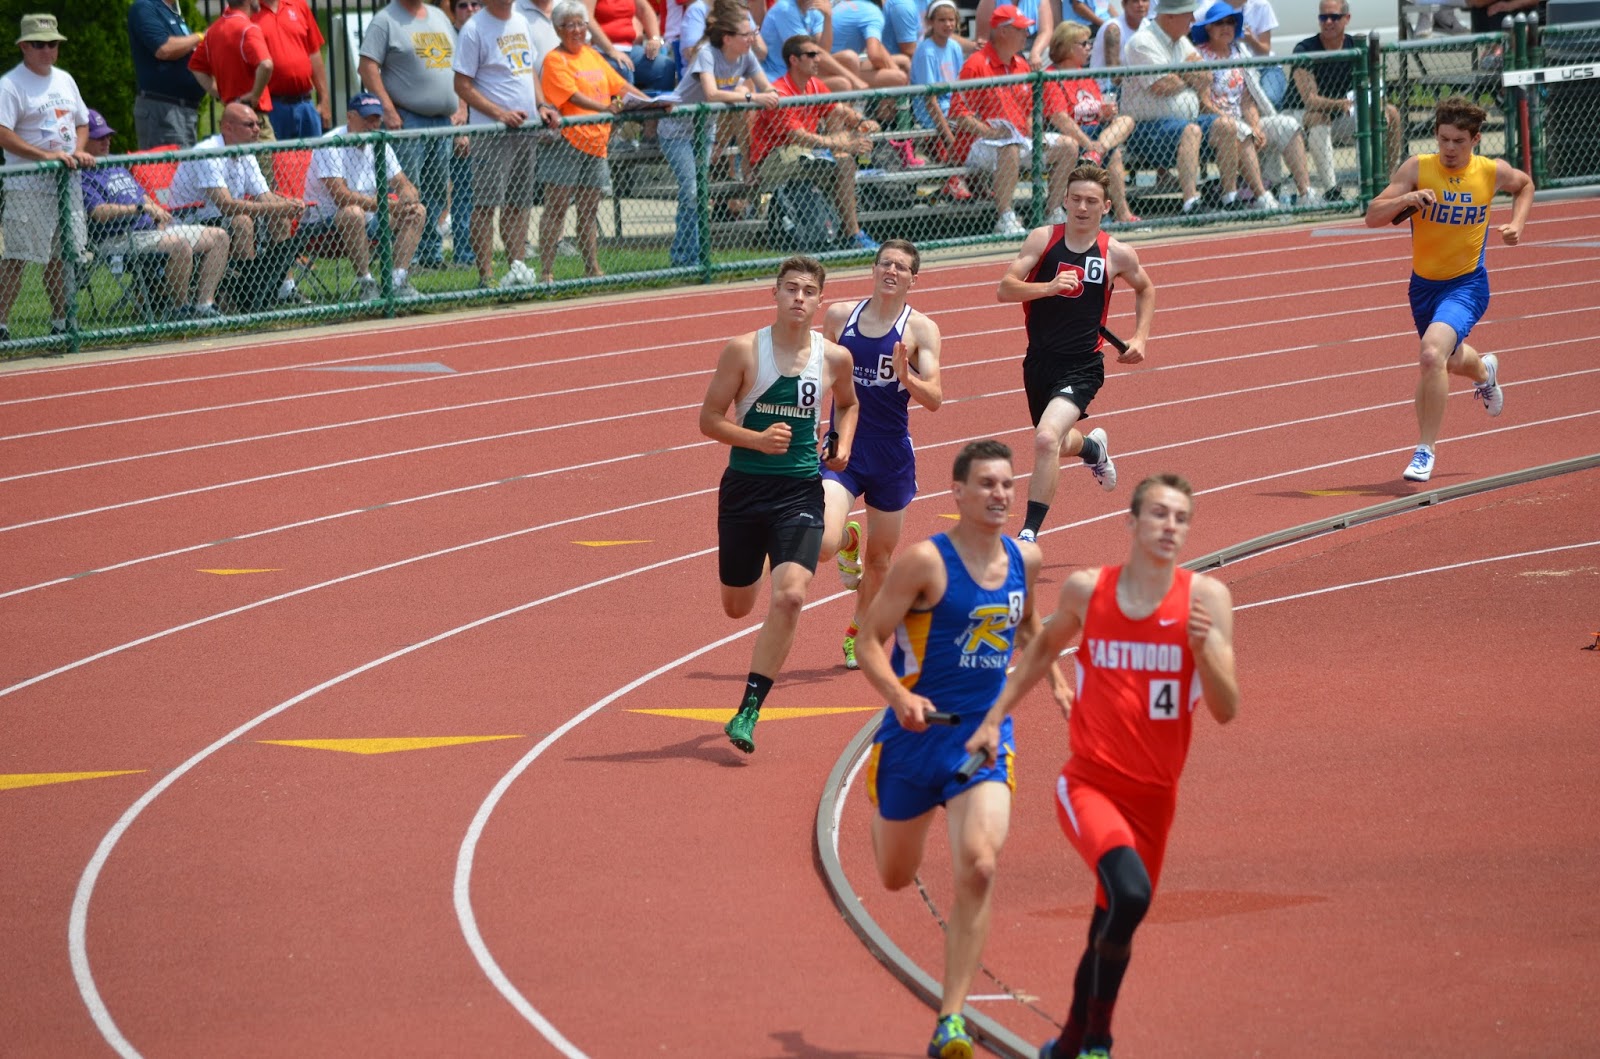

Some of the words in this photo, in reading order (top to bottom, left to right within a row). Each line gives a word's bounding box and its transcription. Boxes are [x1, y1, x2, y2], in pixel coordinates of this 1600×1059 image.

[507, 51, 531, 69] IVC
[1561, 67, 1594, 79] UCS
[1087, 259, 1102, 281] 6
[879, 356, 895, 380] 5
[801, 381, 816, 406] 8
[755, 402, 812, 419] SMITHVILLE
[1009, 595, 1020, 624] 3
[1153, 683, 1175, 716] 4
